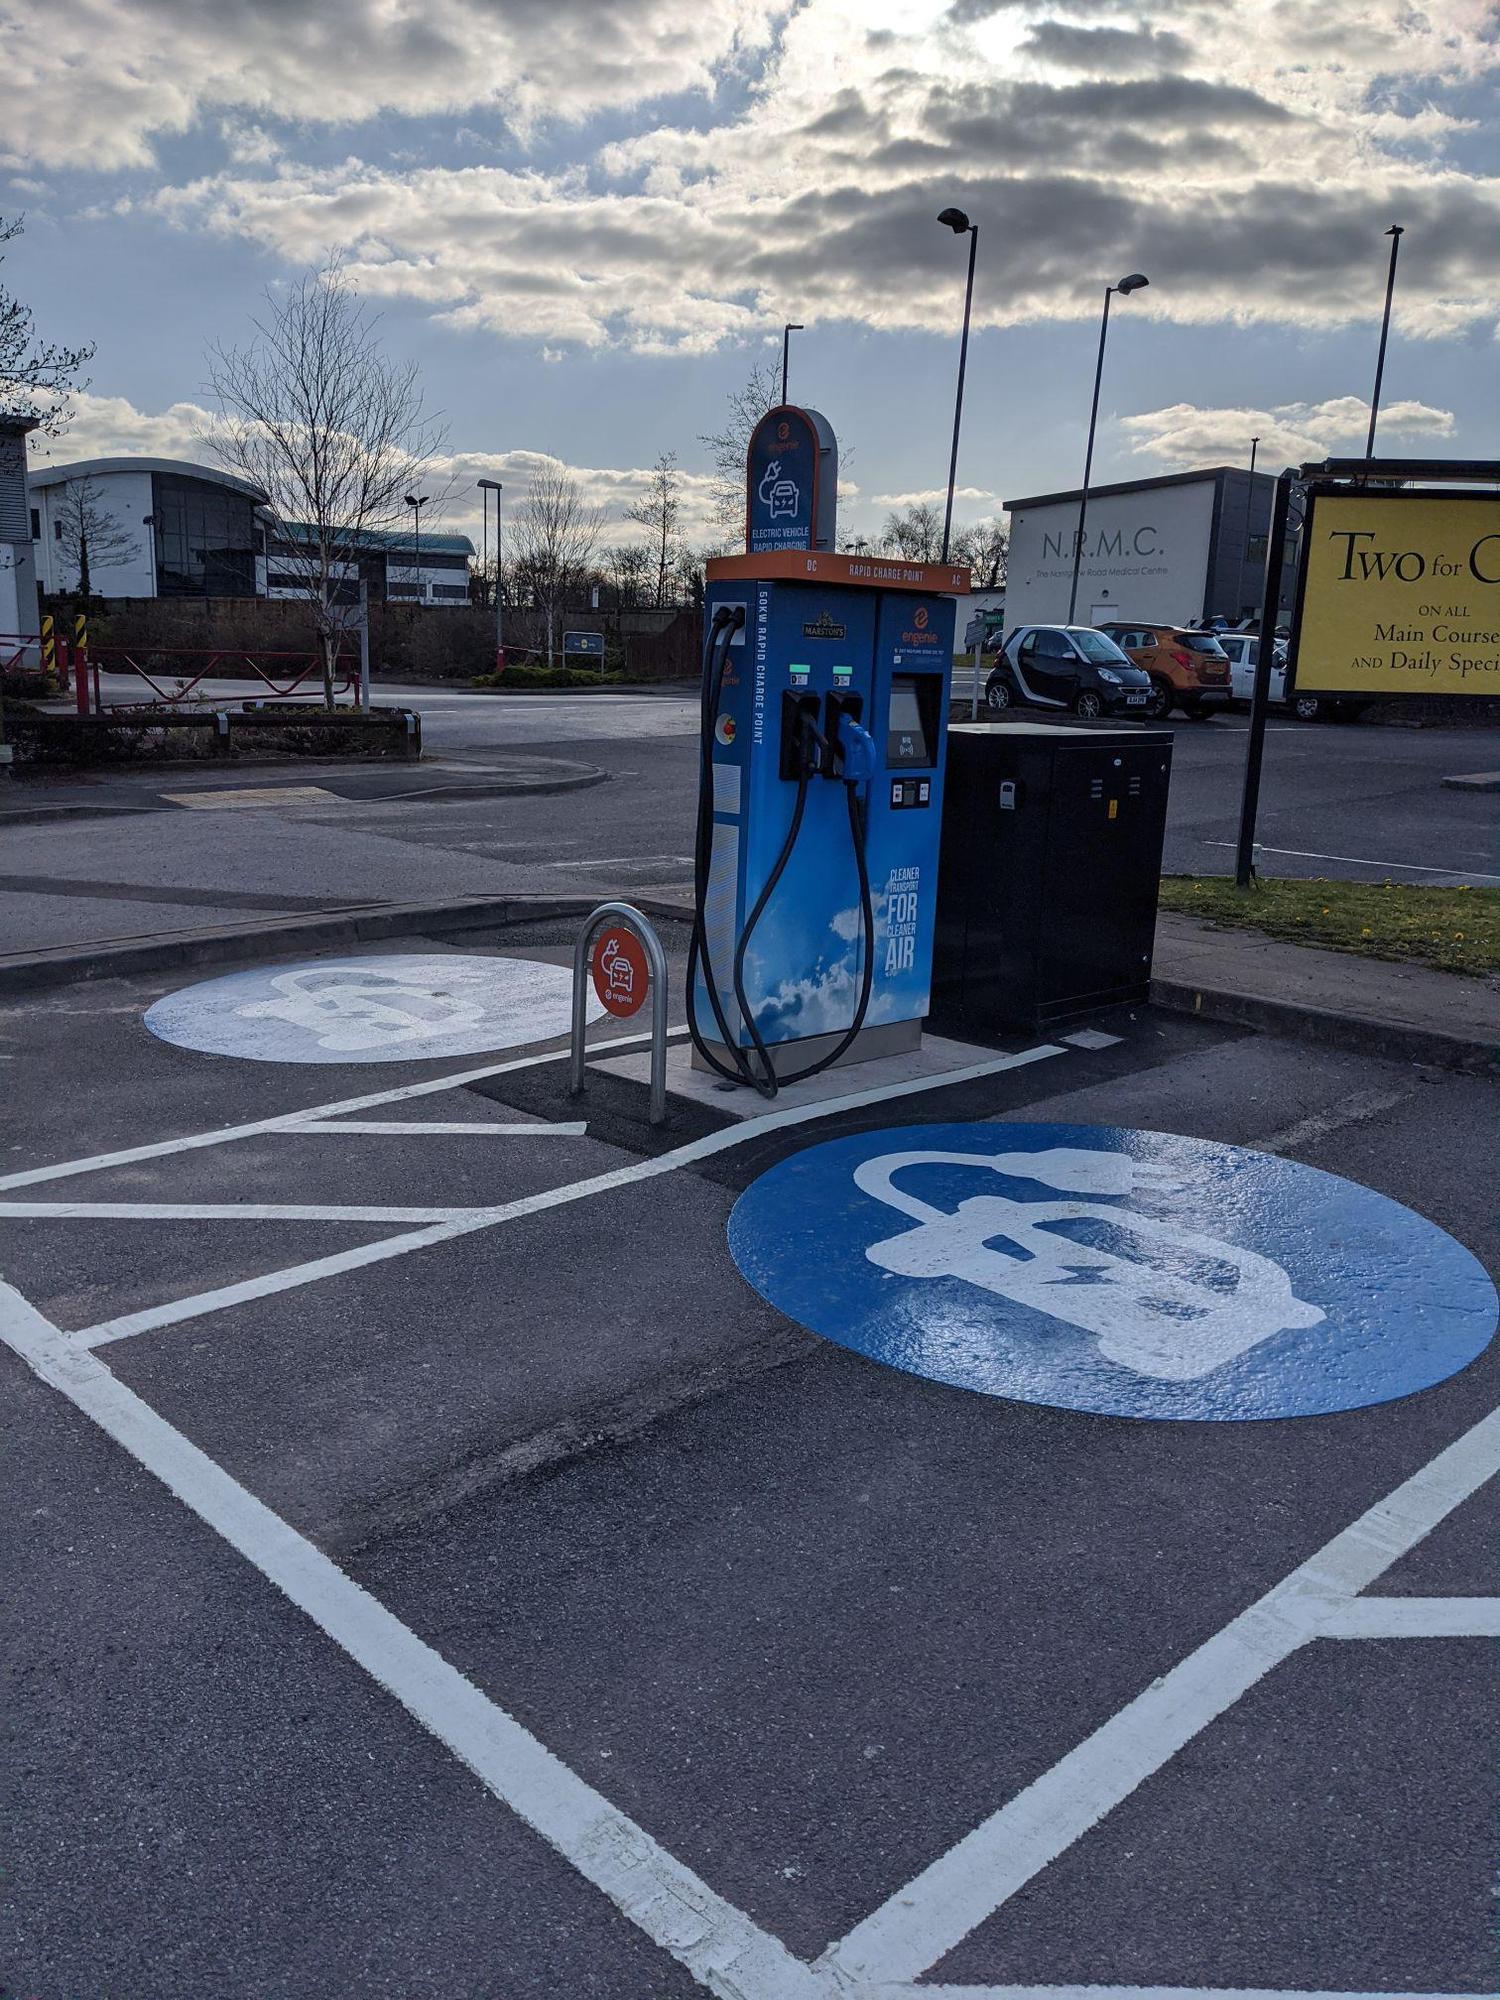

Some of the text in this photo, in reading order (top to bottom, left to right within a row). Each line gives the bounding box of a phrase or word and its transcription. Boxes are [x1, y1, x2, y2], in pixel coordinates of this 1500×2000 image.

[752, 527, 809, 539] ELECTRIC VEHICLE
[753, 541, 807, 552] RAPID CHARGING
[1042, 526, 1164, 559] N.R.M.C.
[806, 559, 817, 572] DC
[849, 564, 924, 582] RAPID CHARGE POINT
[1109, 566, 1140, 577] Medical
[1431, 554, 1462, 577] for
[951, 574, 961, 586] AC
[1418, 605, 1471, 617] ON ALL
[1373, 624, 1500, 644] Main Course
[757, 627, 767, 661] RAPID
[1351, 657, 1383, 669] AND
[1390, 651, 1442, 677] Daily
[755, 665, 766, 708] CHARGE
[753, 713, 764, 745] POINT
[890, 867, 920, 881] CLEANER
[890, 881, 919, 893] TRANSPORT
[888, 892, 918, 924] FOR
[886, 922, 917, 938] CLEANER
[885, 936, 915, 971] AIR
